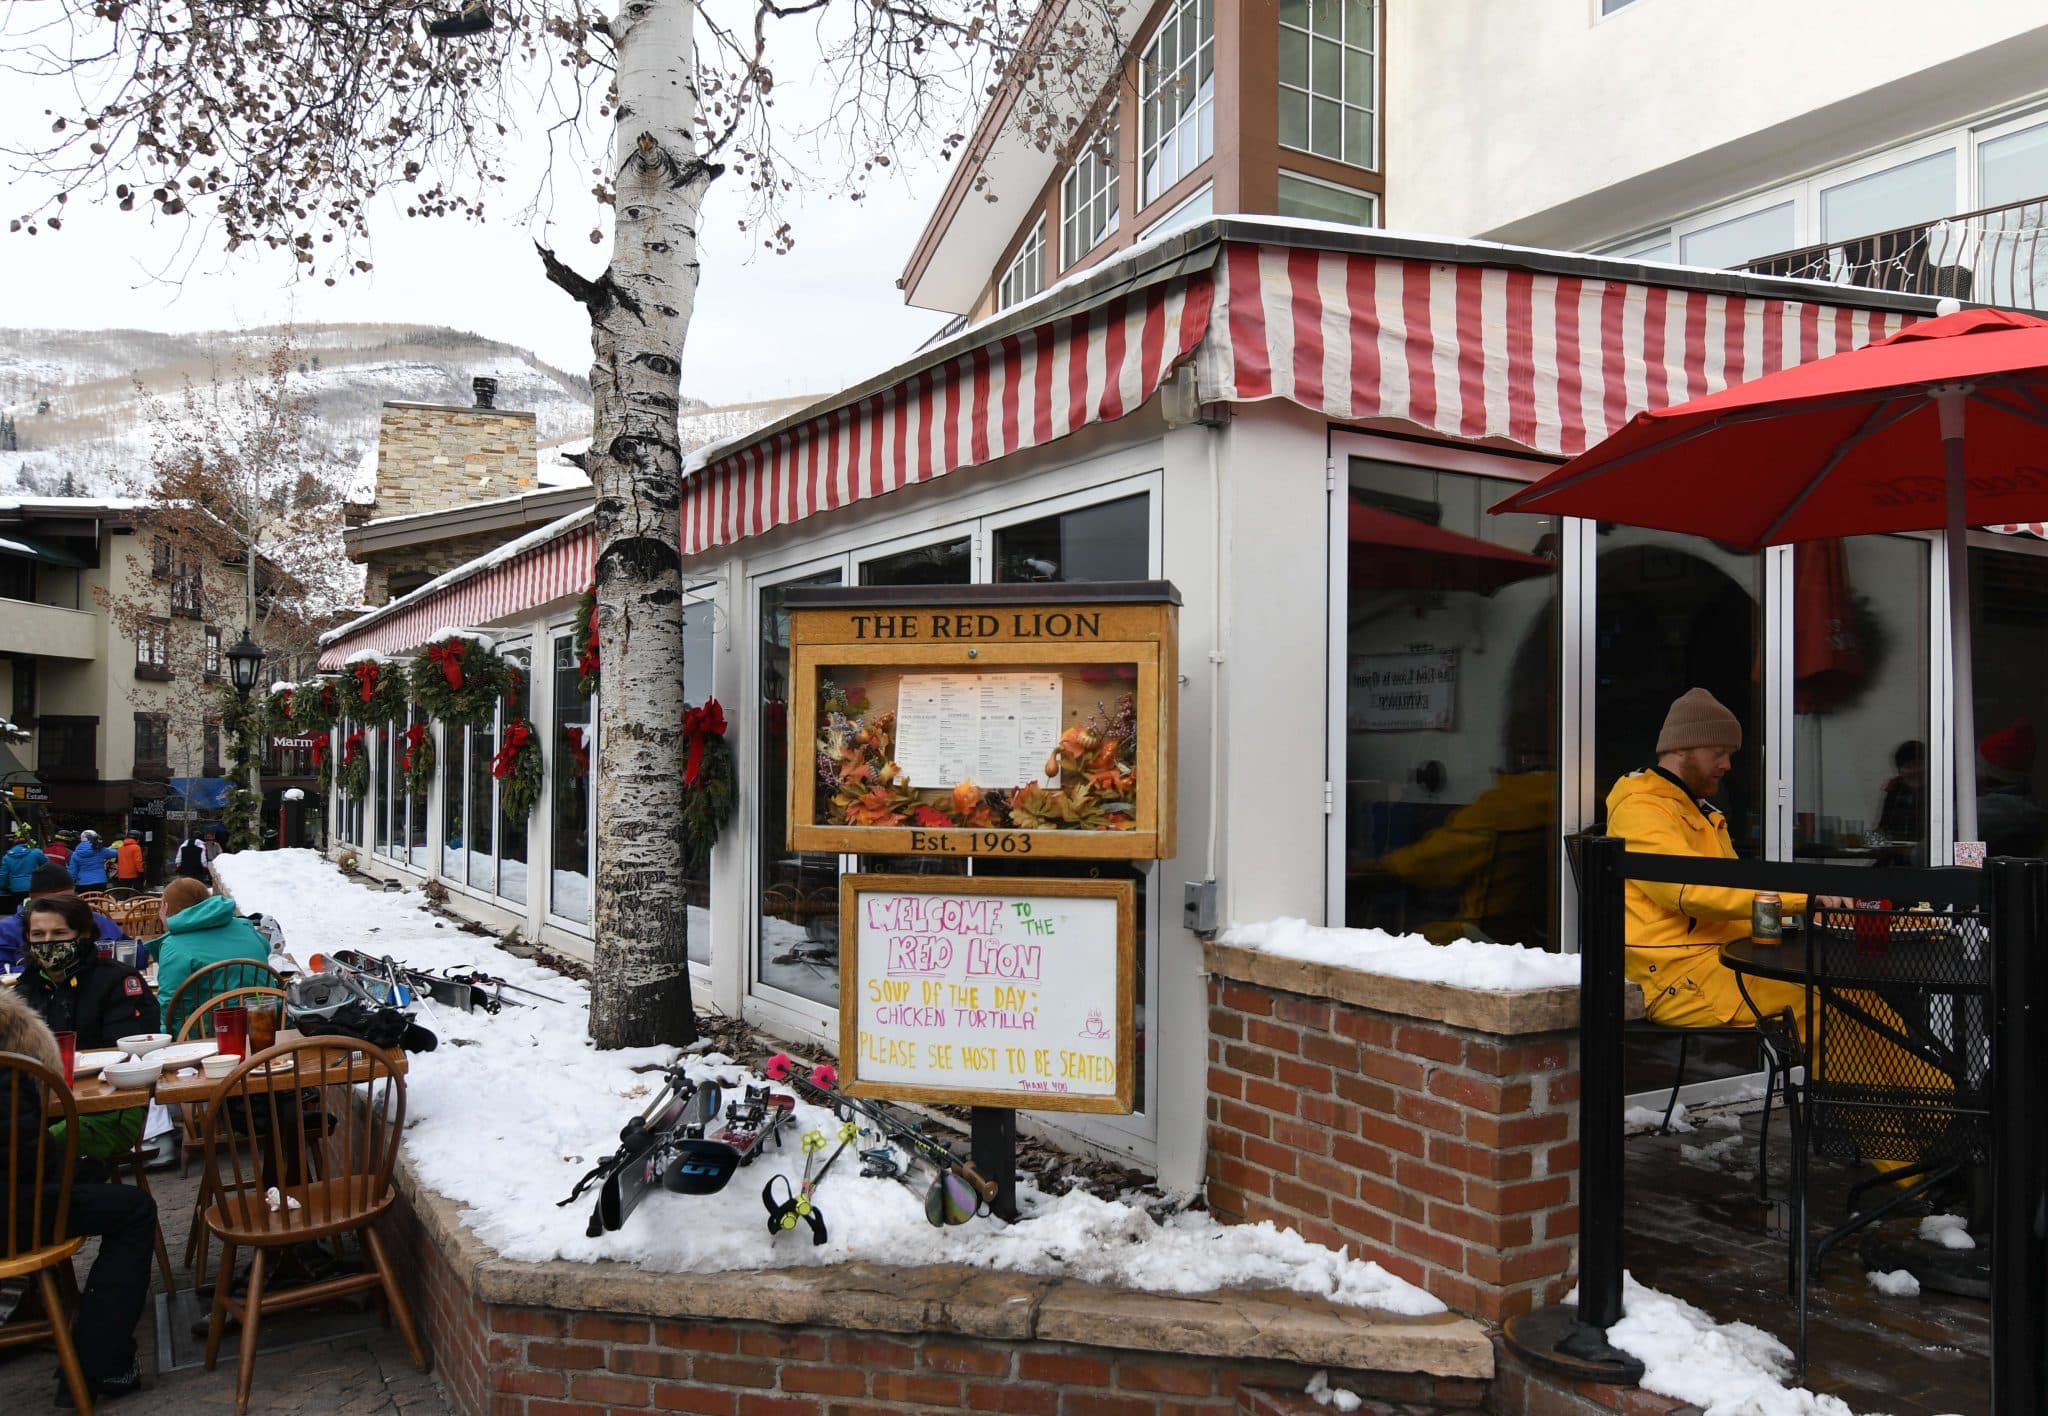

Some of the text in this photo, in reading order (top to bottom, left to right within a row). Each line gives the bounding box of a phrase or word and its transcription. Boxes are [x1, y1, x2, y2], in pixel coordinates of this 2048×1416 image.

[851, 612, 1102, 639] THE RED LION
[911, 832, 1032, 853] Est. 1963
[867, 897, 1031, 935] WELCOME TO
[1020, 919, 1055, 936] THE
[888, 935, 953, 971] RED
[868, 979, 910, 1003] SOUP
[949, 984, 979, 1010] THE
[859, 1031, 1115, 1083] PLEASE SEE HOST TO BE SEATED
